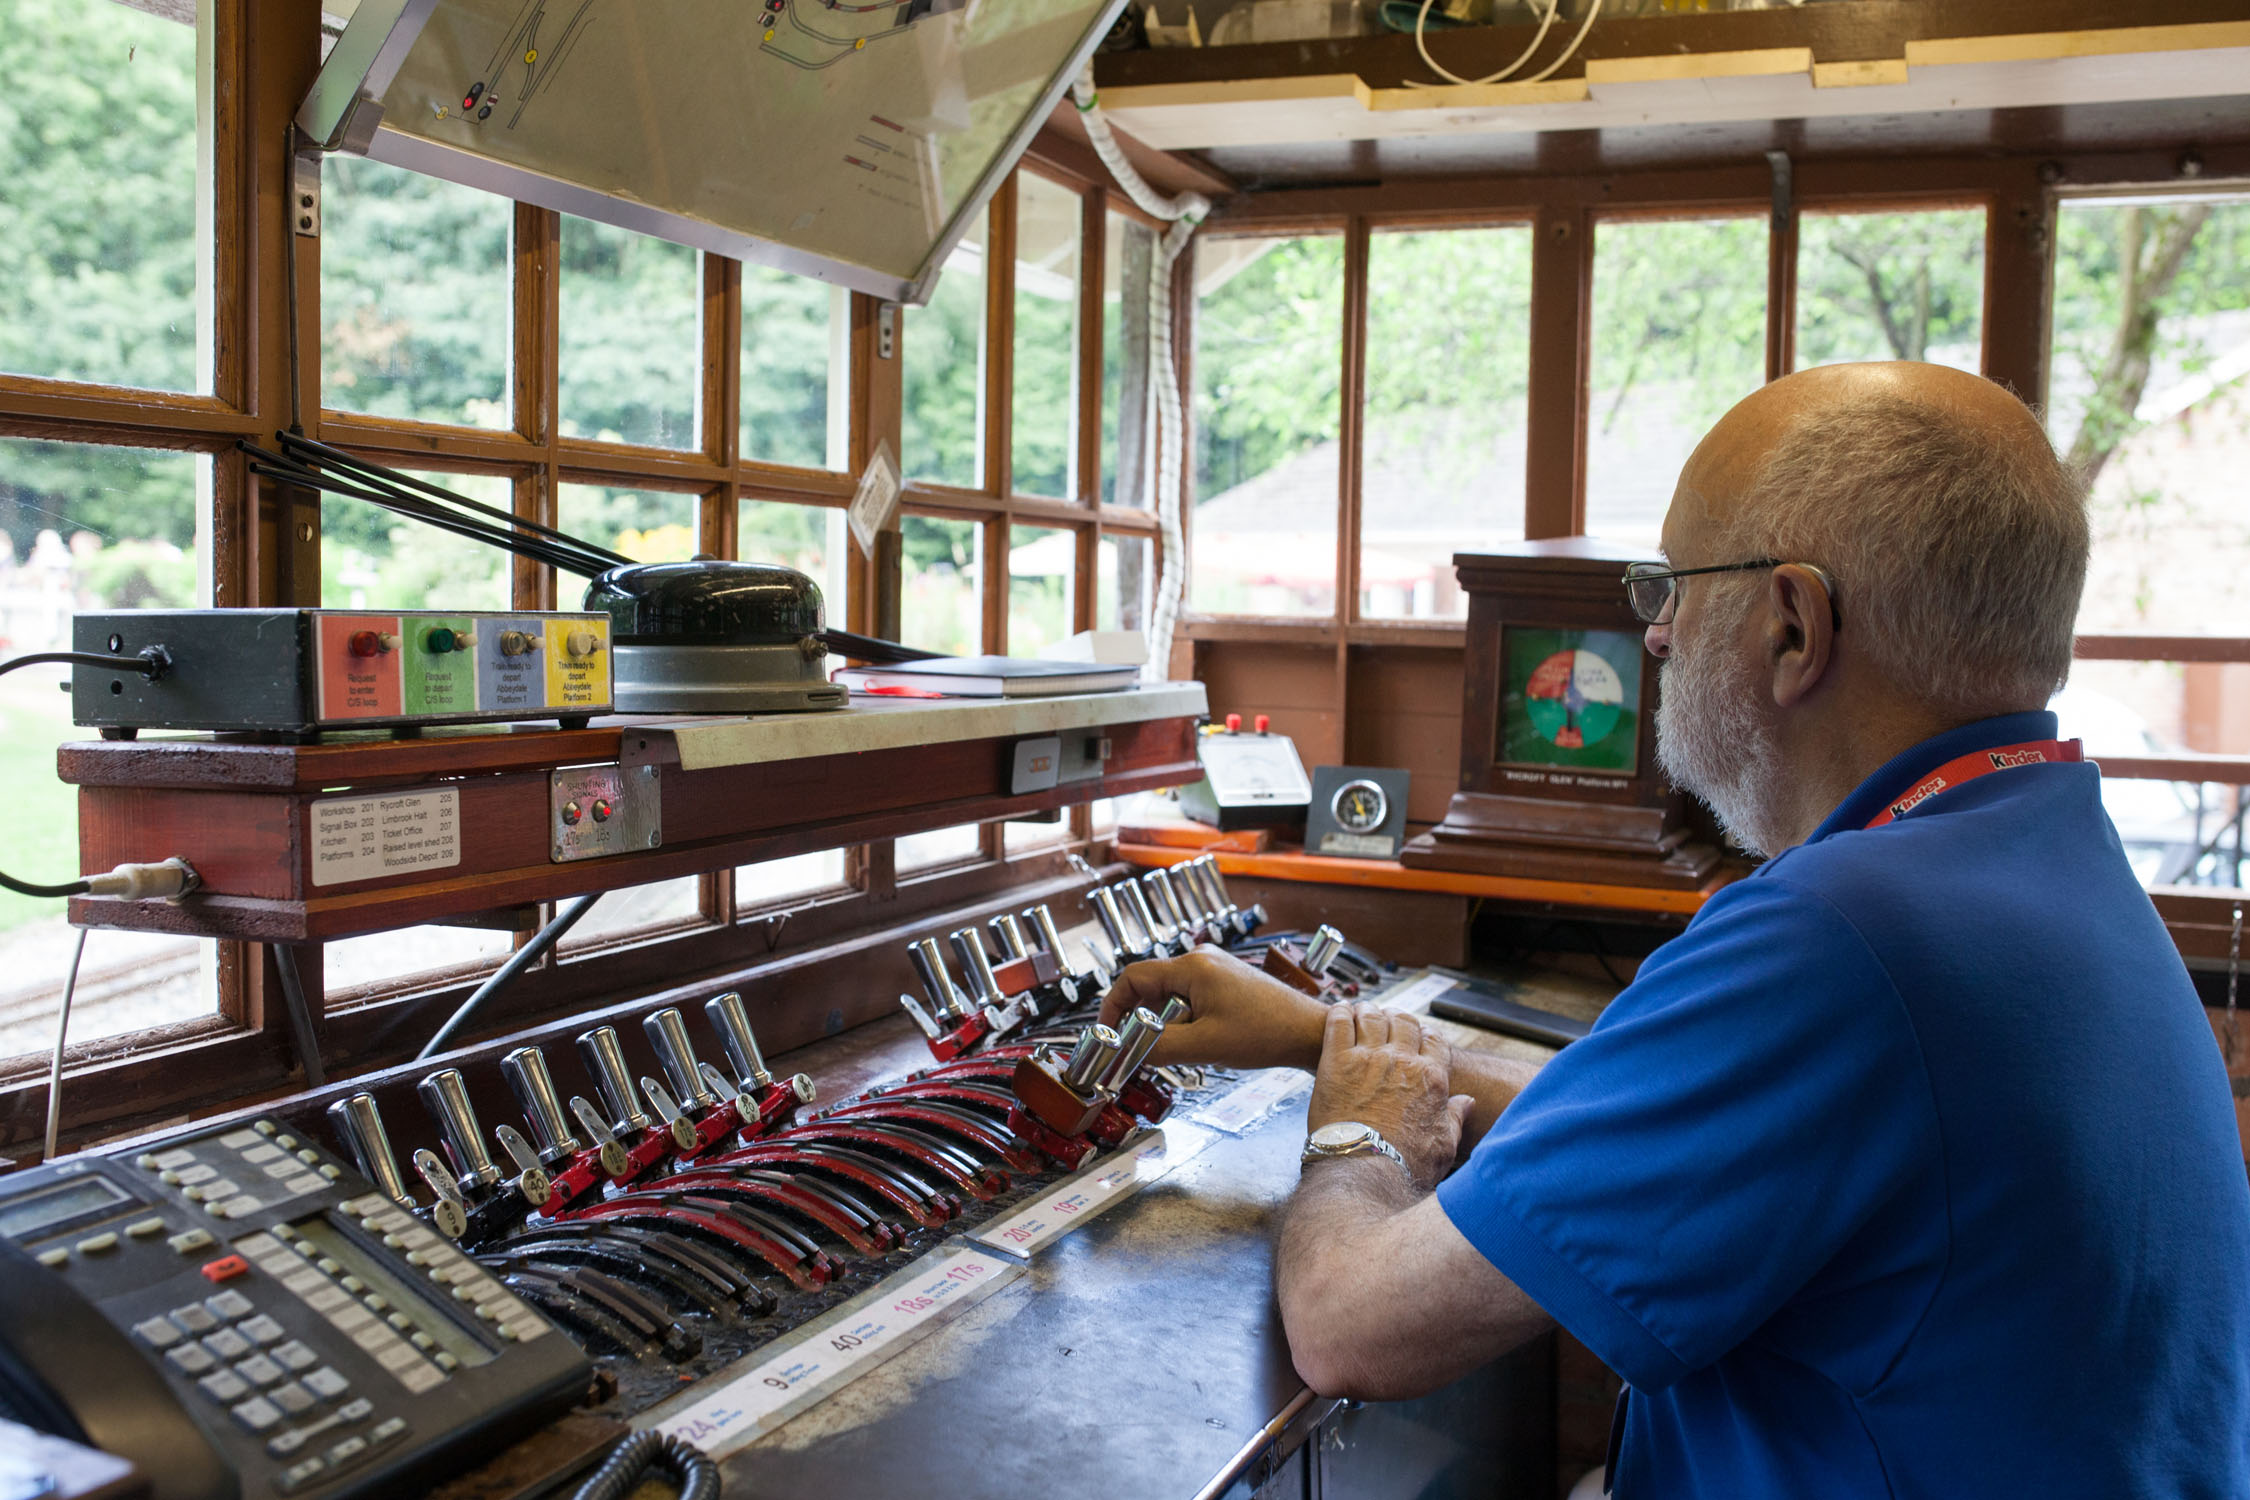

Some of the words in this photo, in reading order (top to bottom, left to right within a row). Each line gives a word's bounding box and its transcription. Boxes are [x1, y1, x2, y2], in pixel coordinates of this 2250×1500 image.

[319, 805, 356, 818] Workshop
[361, 803, 374, 813] 201
[380, 799, 404, 811] Rycroft
[405, 798, 421, 807] Glen
[439, 794, 453, 803] 205
[382, 813, 413, 825] Limbrook
[414, 811, 428, 820] Halt
[439, 808, 453, 818] 206
[319, 821, 342, 834] Signal
[344, 820, 357, 829] Box
[361, 817, 374, 828] 202
[382, 828, 402, 838] Ticket
[403, 825, 423, 836] Office
[439, 822, 452, 832] 207
[320, 836, 347, 847] Kitchen
[361, 832, 374, 842] 203
[383, 842, 407, 853] Raised
[407, 840, 423, 849] level
[424, 837, 440, 847] shed
[441, 835, 454, 845] 208
[320, 850, 354, 862] Platforms
[361, 846, 375, 857] 204
[384, 855, 418, 867] Woodside
[418, 851, 439, 863] Depot
[441, 849, 454, 859] 209
[744, 1102, 756, 1115] 20
[529, 1177, 545, 1191] 40
[1051, 1201, 1079, 1215] 19
[446, 1211, 456, 1226] 9
[1002, 1227, 1033, 1243] 20
[945, 1263, 985, 1282] 17s
[893, 1296, 935, 1315] 18s
[830, 1333, 863, 1352] 40
[762, 1377, 790, 1391] 9
[676, 1419, 718, 1441] 24
